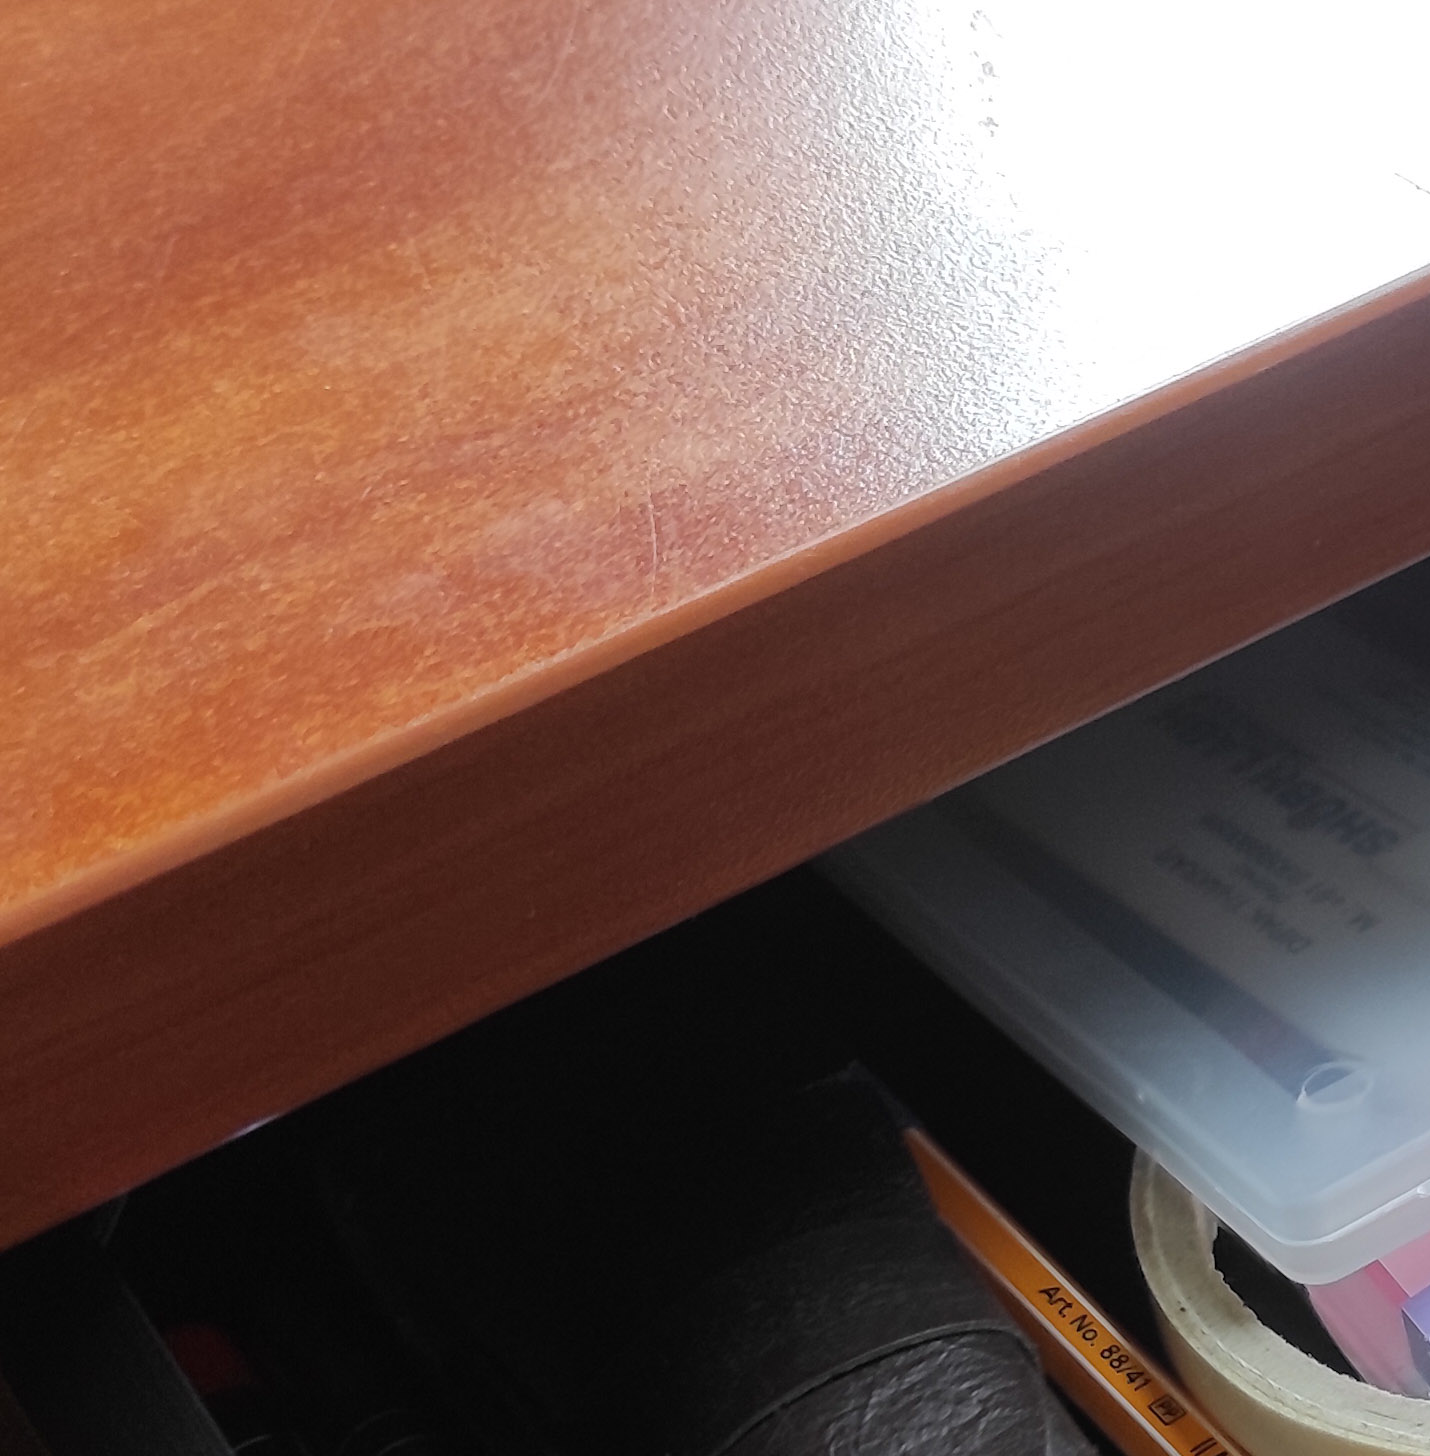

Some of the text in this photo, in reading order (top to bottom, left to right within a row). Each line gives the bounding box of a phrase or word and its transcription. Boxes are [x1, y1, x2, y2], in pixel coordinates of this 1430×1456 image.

[1038, 1286, 1151, 1392] Art. No. 88/41
